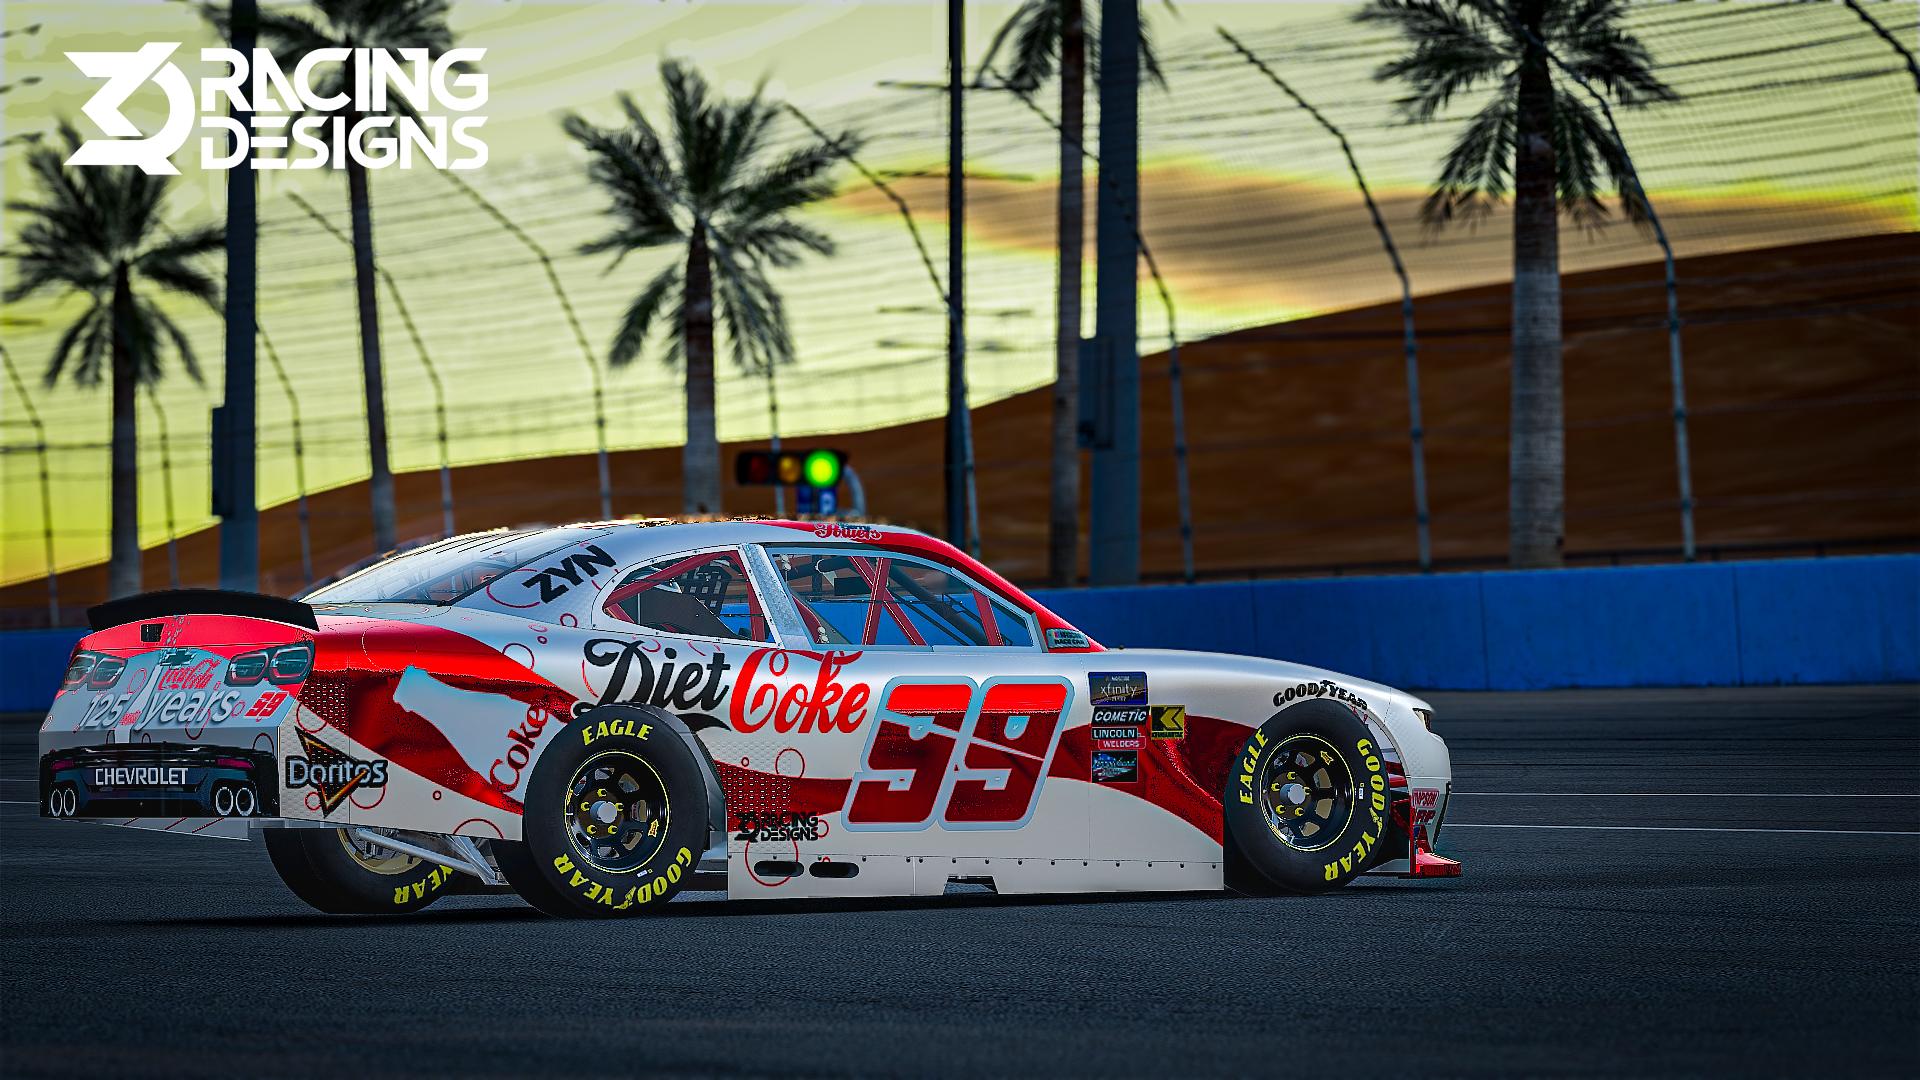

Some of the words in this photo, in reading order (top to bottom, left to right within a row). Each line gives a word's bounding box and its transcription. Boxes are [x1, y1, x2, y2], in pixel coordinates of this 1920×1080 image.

[522, 545, 617, 604] ZYN
[572, 638, 731, 718] Diet
[729, 648, 871, 734] Coke
[1101, 682, 1138, 699] xfinity
[79, 691, 132, 729] 125
[135, 690, 240, 731] years
[1094, 710, 1147, 722] COMETIC
[582, 719, 654, 746] EAGLE
[1093, 729, 1135, 739] LINCOLN
[1103, 740, 1140, 748] WELDERS
[489, 702, 550, 794] Coke
[95, 767, 188, 785] CHEVROLET
[288, 757, 387, 787] Doritos
[1239, 728, 1269, 805] EAGLE
[761, 827, 819, 841] DESIGNS
